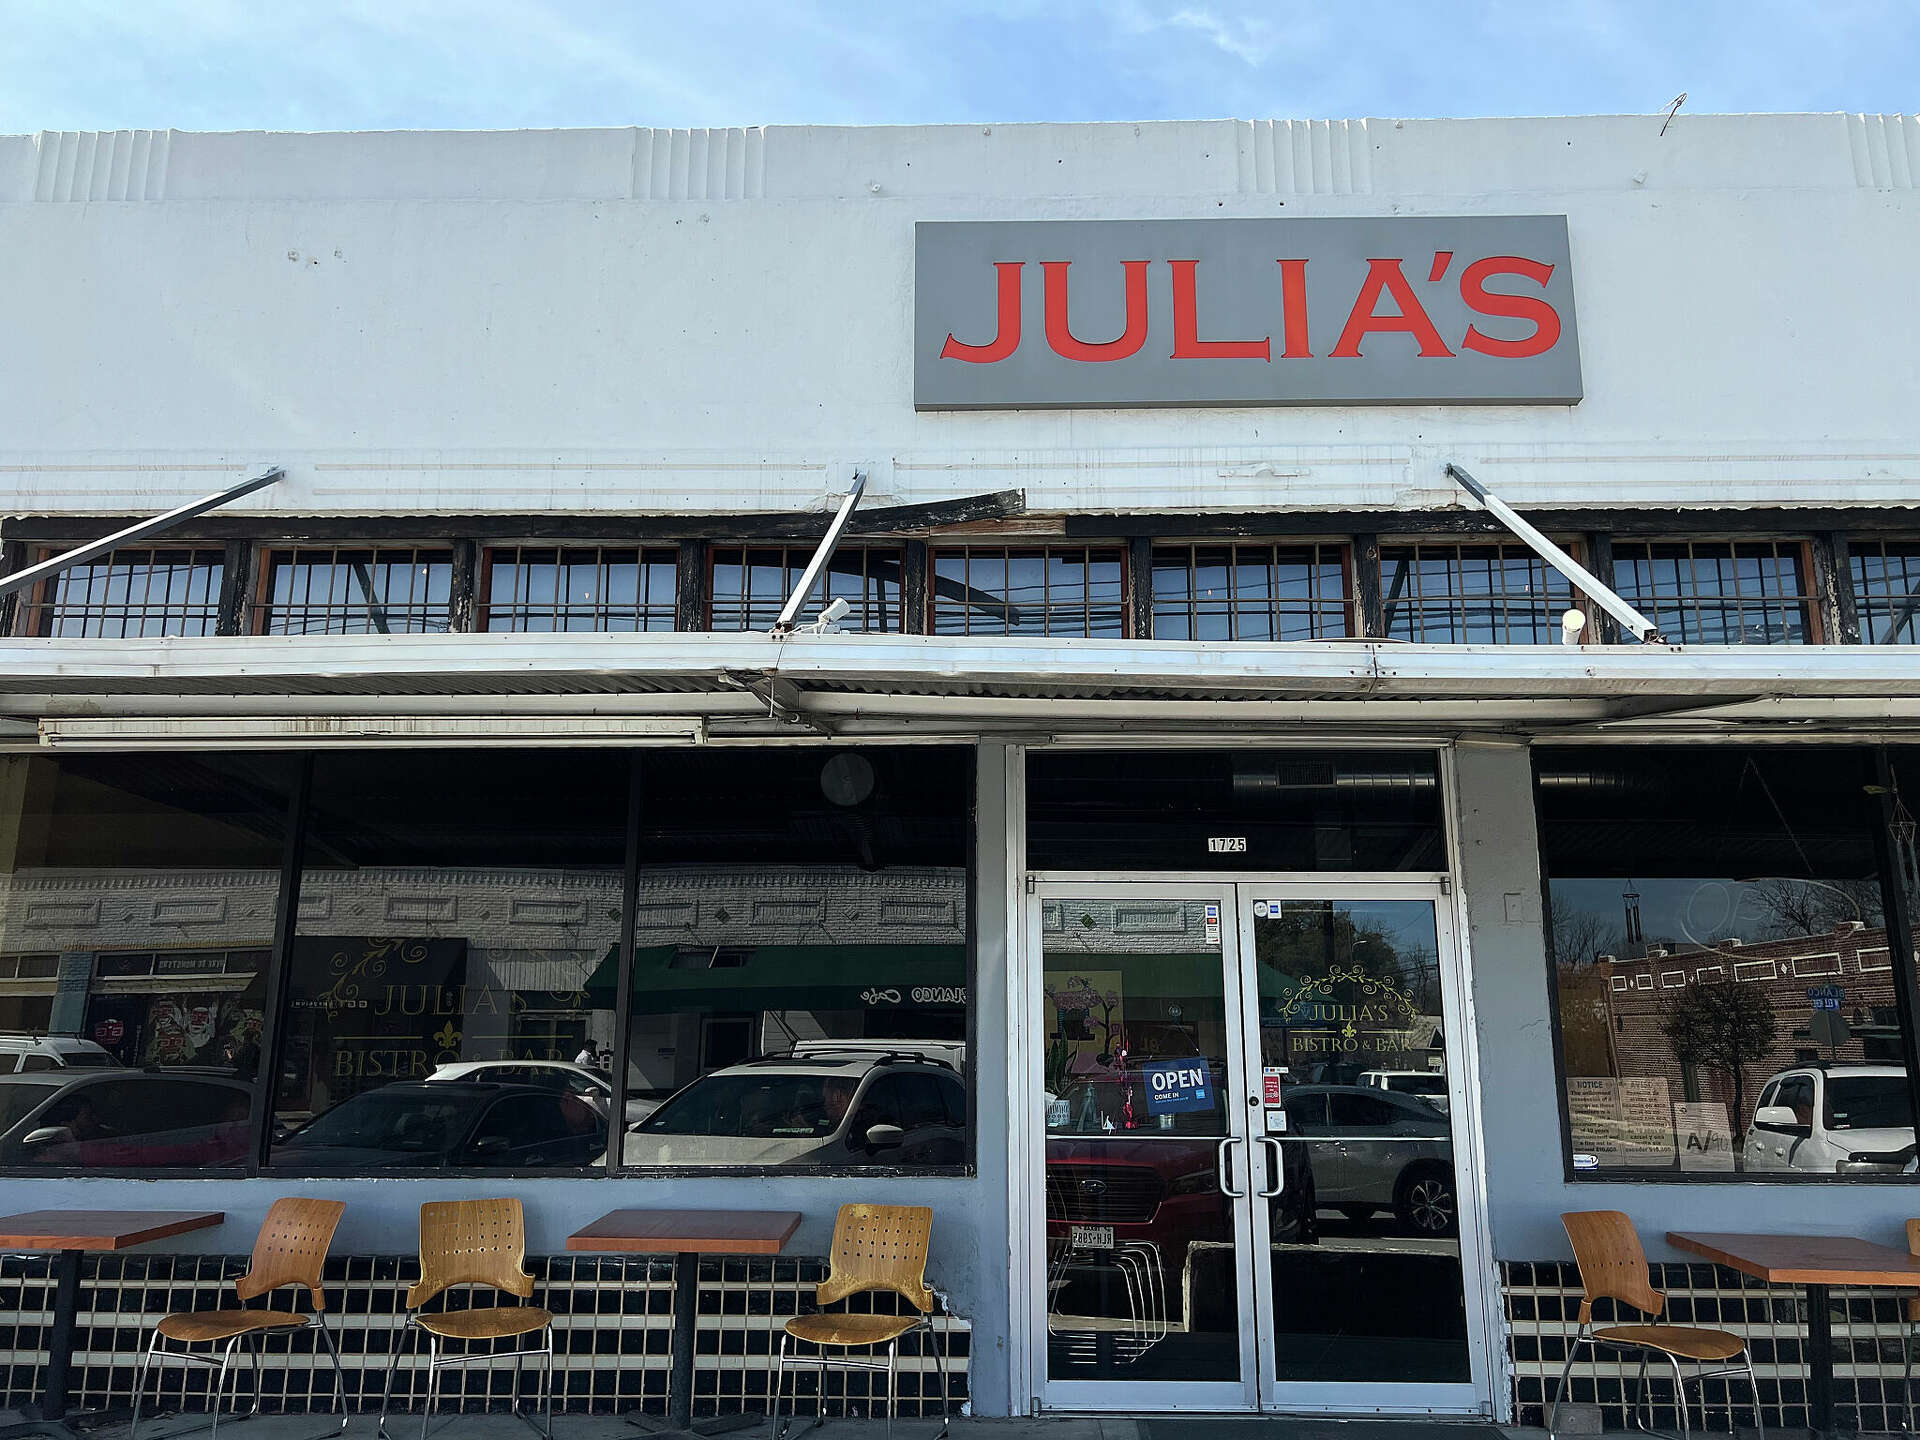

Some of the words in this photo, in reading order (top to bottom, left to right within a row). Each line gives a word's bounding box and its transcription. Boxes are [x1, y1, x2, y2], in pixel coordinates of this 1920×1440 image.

[941, 250, 1562, 364] JULIA'S
[1211, 838, 1245, 851] 1725
[375, 983, 528, 1016] JULIAS
[1309, 1003, 1389, 1021] JULIA'S
[1292, 1037, 1358, 1053] BISTRO
[1362, 1040, 1371, 1051] &
[1375, 1038, 1413, 1052] BAR
[334, 1049, 461, 1078] BISTRO
[1151, 1067, 1204, 1091] OPEN
[1576, 1080, 1604, 1089] NOTICE
[1154, 1093, 1172, 1101] COME
